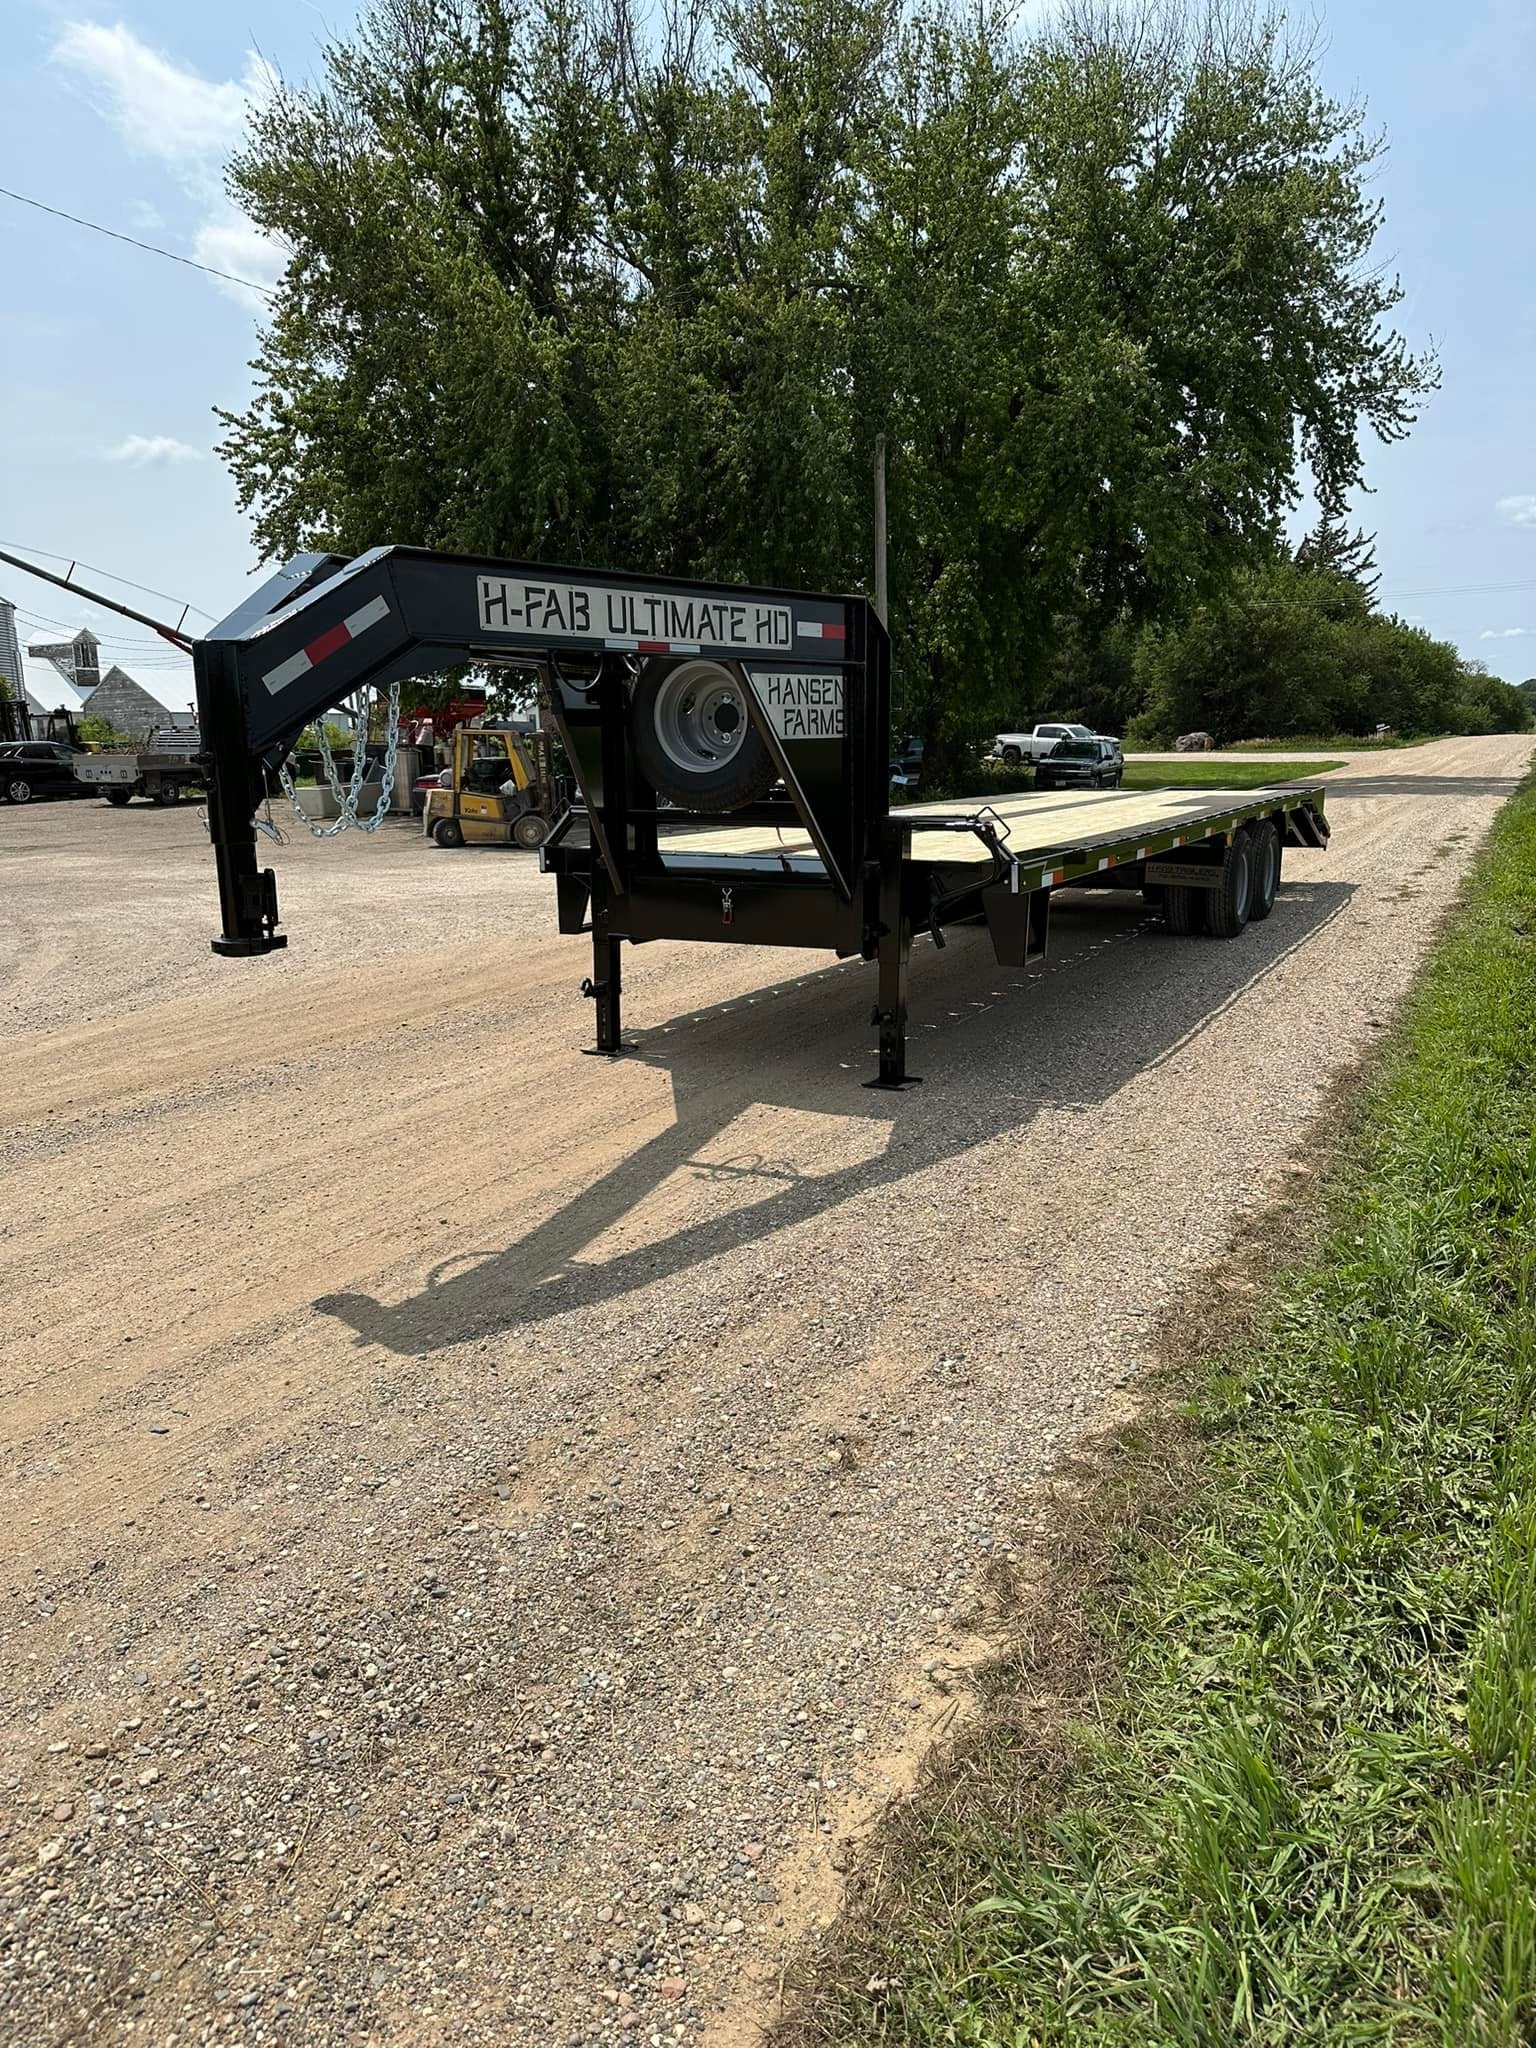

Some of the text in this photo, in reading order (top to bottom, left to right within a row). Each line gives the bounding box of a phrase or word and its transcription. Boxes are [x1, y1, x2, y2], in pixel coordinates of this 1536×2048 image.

[483, 582, 789, 645] H-FAB ULTIMATE HD
[768, 677, 845, 704] HANSEN
[784, 708, 845, 735] FARMS
